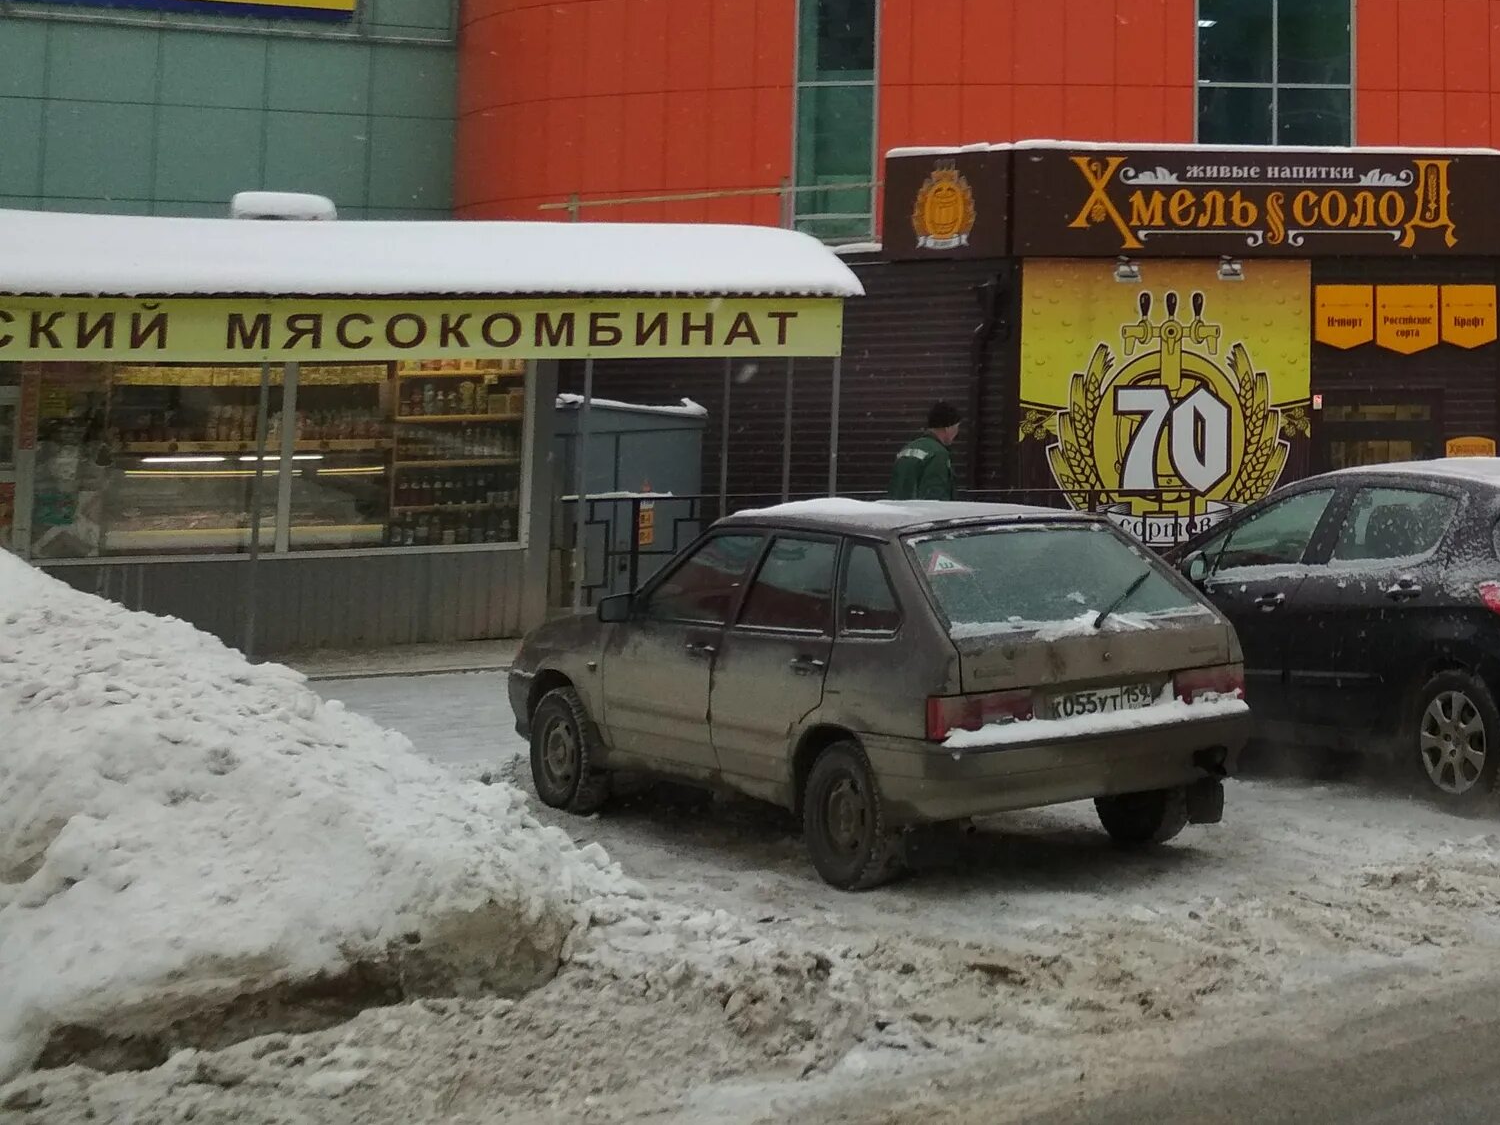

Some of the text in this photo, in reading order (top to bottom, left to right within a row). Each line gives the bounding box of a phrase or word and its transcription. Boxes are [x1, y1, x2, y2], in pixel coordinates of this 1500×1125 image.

[1186, 164, 1354, 180] живые напитки
[226, 311, 799, 350] МЯСОКОМБИНАТ
[1396, 328, 1420, 338] сорта
[1114, 386, 1232, 497] 70
